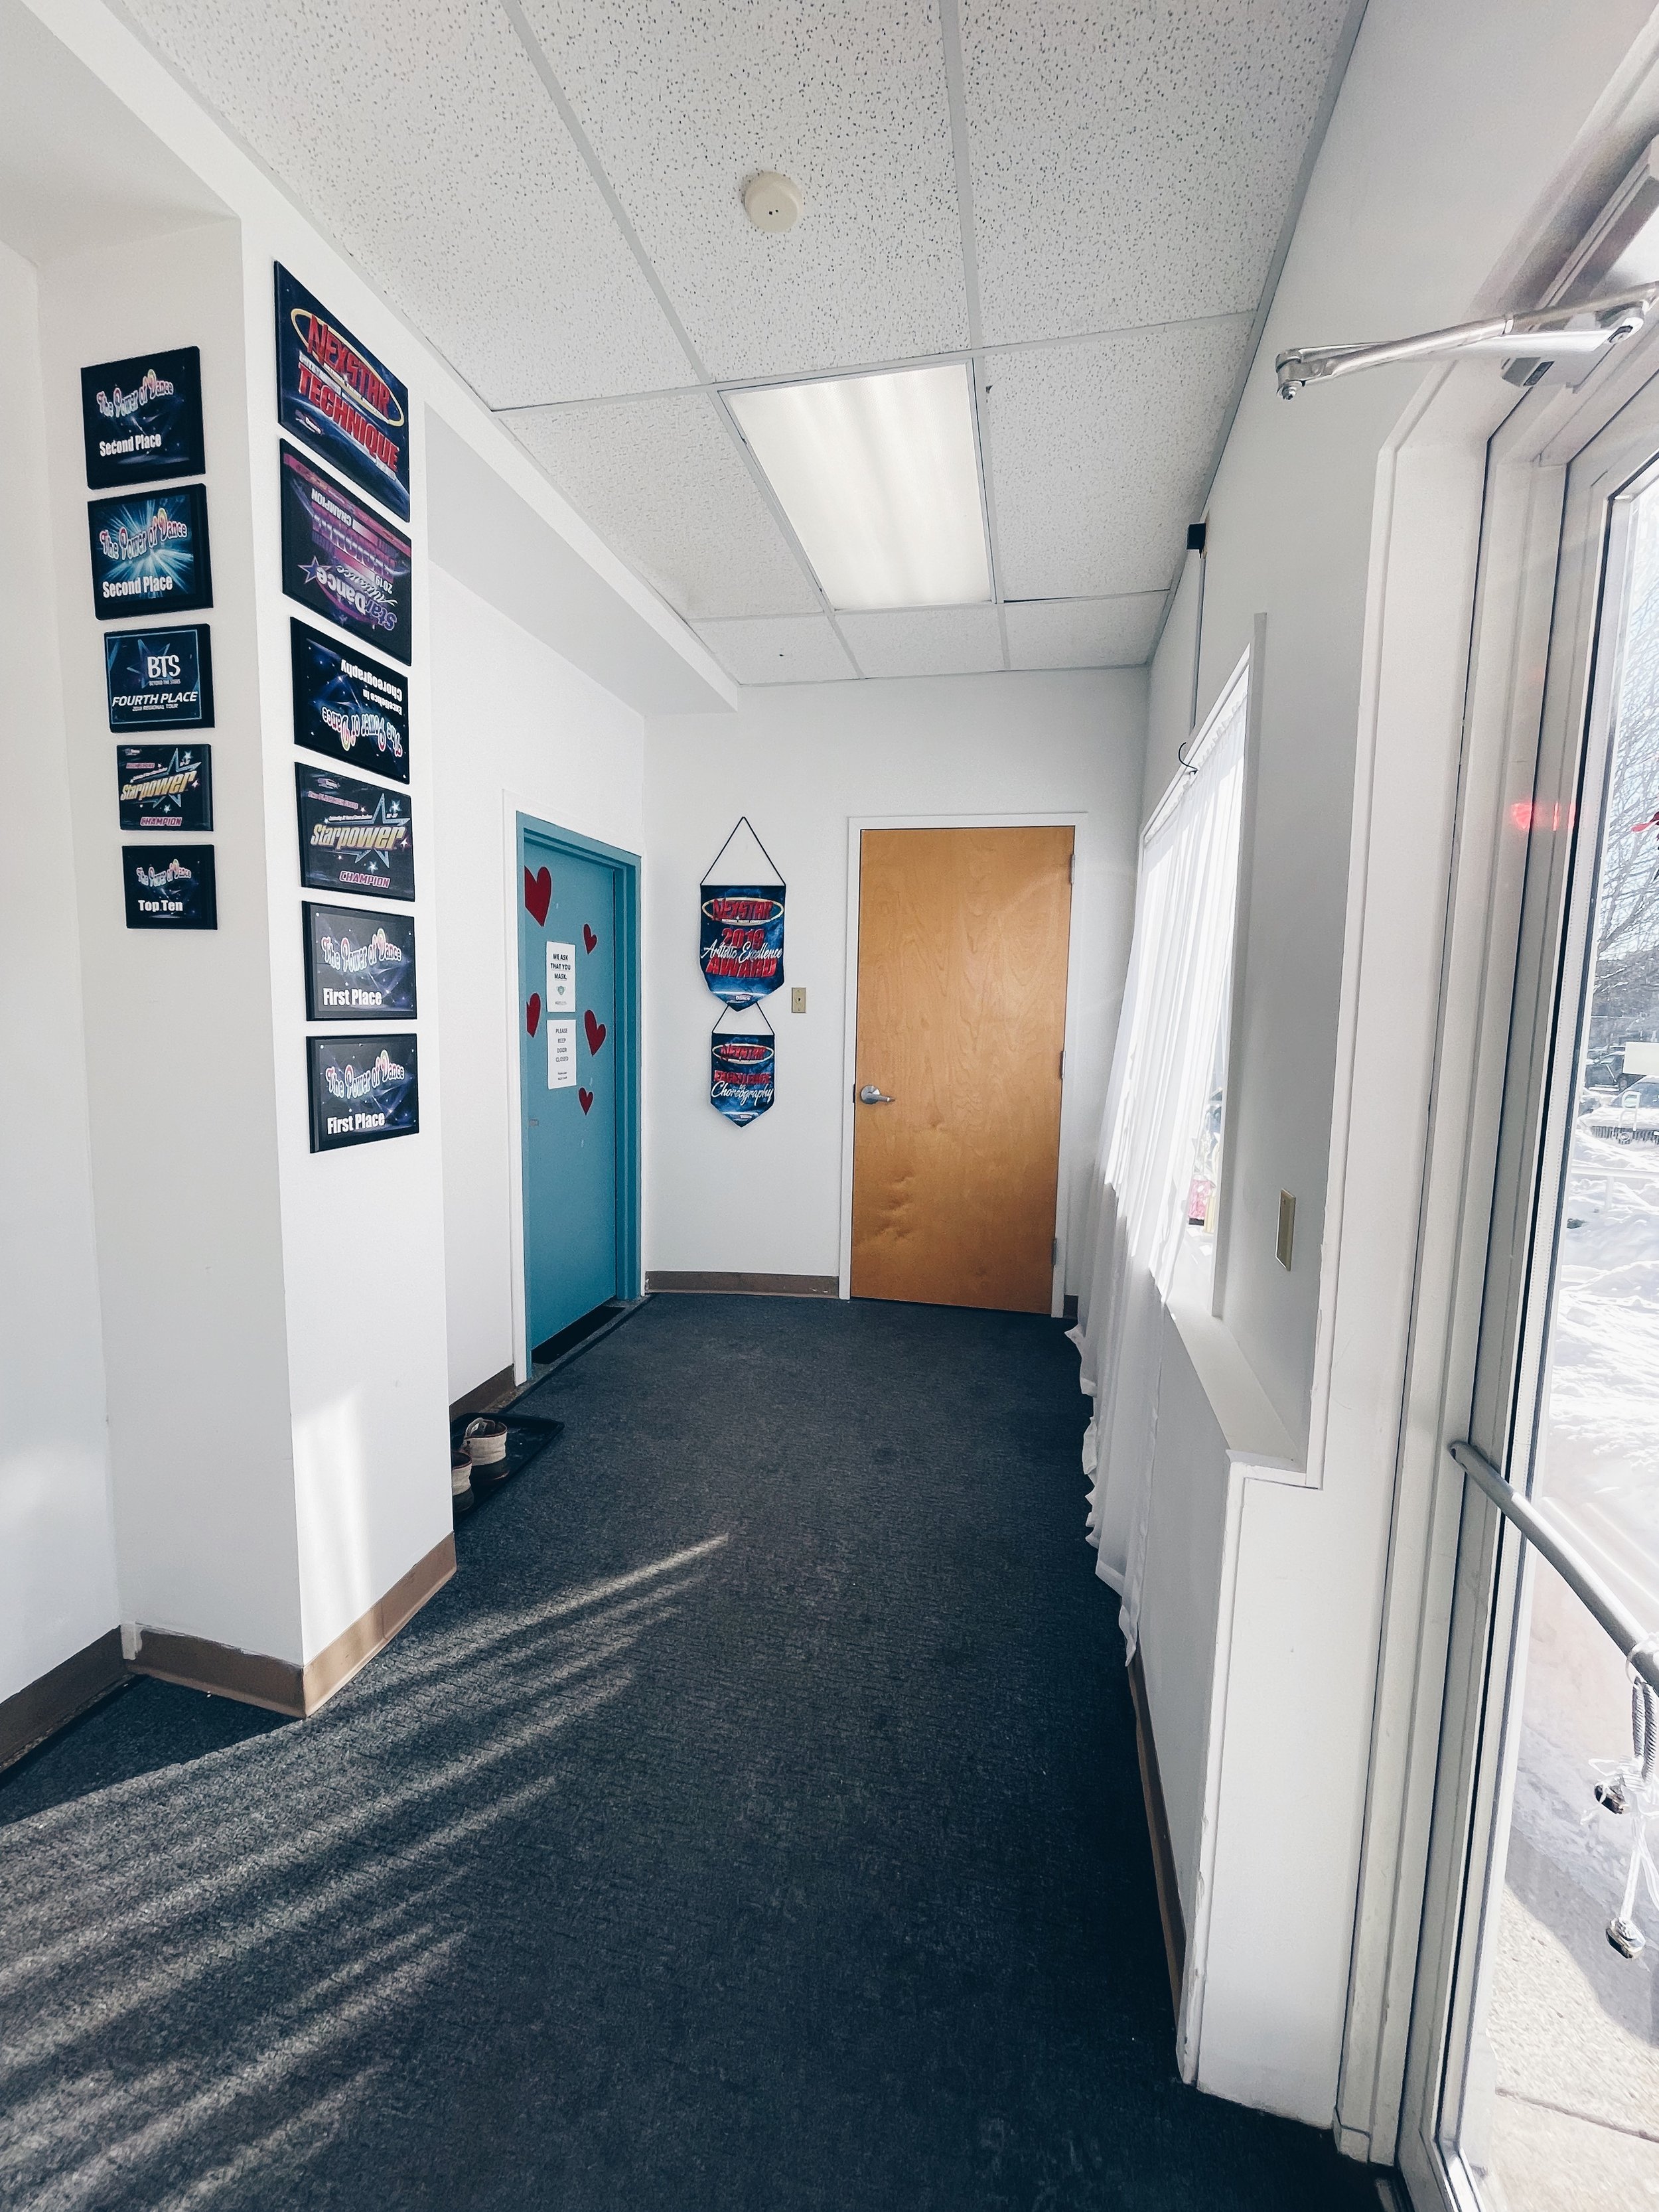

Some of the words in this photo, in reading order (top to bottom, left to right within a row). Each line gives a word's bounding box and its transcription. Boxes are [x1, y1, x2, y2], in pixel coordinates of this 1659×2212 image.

[307, 314, 392, 418] NEXSTAR
[97, 391, 114, 418] The
[113, 387, 138, 417] Power
[139, 375, 148, 406] of
[147, 368, 173, 397] Dance
[297, 362, 399, 473] TECHNIQUE
[99, 436, 133, 457] Second
[135, 433, 162, 451] Place
[311, 488, 352, 528] CHAMPION
[100, 530, 119, 560] The
[119, 527, 147, 561] Power
[148, 515, 158, 546] of
[157, 507, 188, 539] Dance
[102, 579, 141, 599] Second
[143, 575, 173, 594] Place
[336, 563, 397, 605] Alliance
[375, 573, 392, 594] 2019
[147, 654, 181, 678] BTS
[340, 659, 403, 701] Choreography
[112, 694, 160, 707] FOURTH
[161, 692, 198, 704] PLACE
[370, 693, 402, 715] Excellence
[322, 706, 349, 751] Dance
[350, 715, 360, 747] of
[361, 713, 386, 752] Power
[387, 721, 403, 757] The
[120, 770, 197, 801] Starpower
[140, 816, 182, 827] CHAMPION
[311, 824, 405, 850] Starpower
[136, 866, 149, 886] The
[167, 862, 173, 882] of
[339, 870, 391, 888] CHAMPION
[138, 900, 160, 912] Top
[161, 900, 183, 911] Ten
[712, 897, 774, 921] NEXSTAR
[321, 936, 340, 971] The
[340, 937, 368, 972] Power
[368, 933, 377, 966] of
[377, 928, 402, 962] Dance
[701, 938, 738, 959] Artistic
[739, 941, 782, 964] Excellence
[705, 956, 777, 978] AWARD
[323, 988, 350, 1006] First
[351, 988, 382, 1005] Place
[325, 1067, 344, 1098] The
[344, 1065, 371, 1099] Power
[372, 1056, 380, 1088] of
[380, 1049, 405, 1082] Dance
[711, 1080, 774, 1106] Choreography
[327, 1114, 354, 1135] First
[354, 1112, 386, 1130] Place
